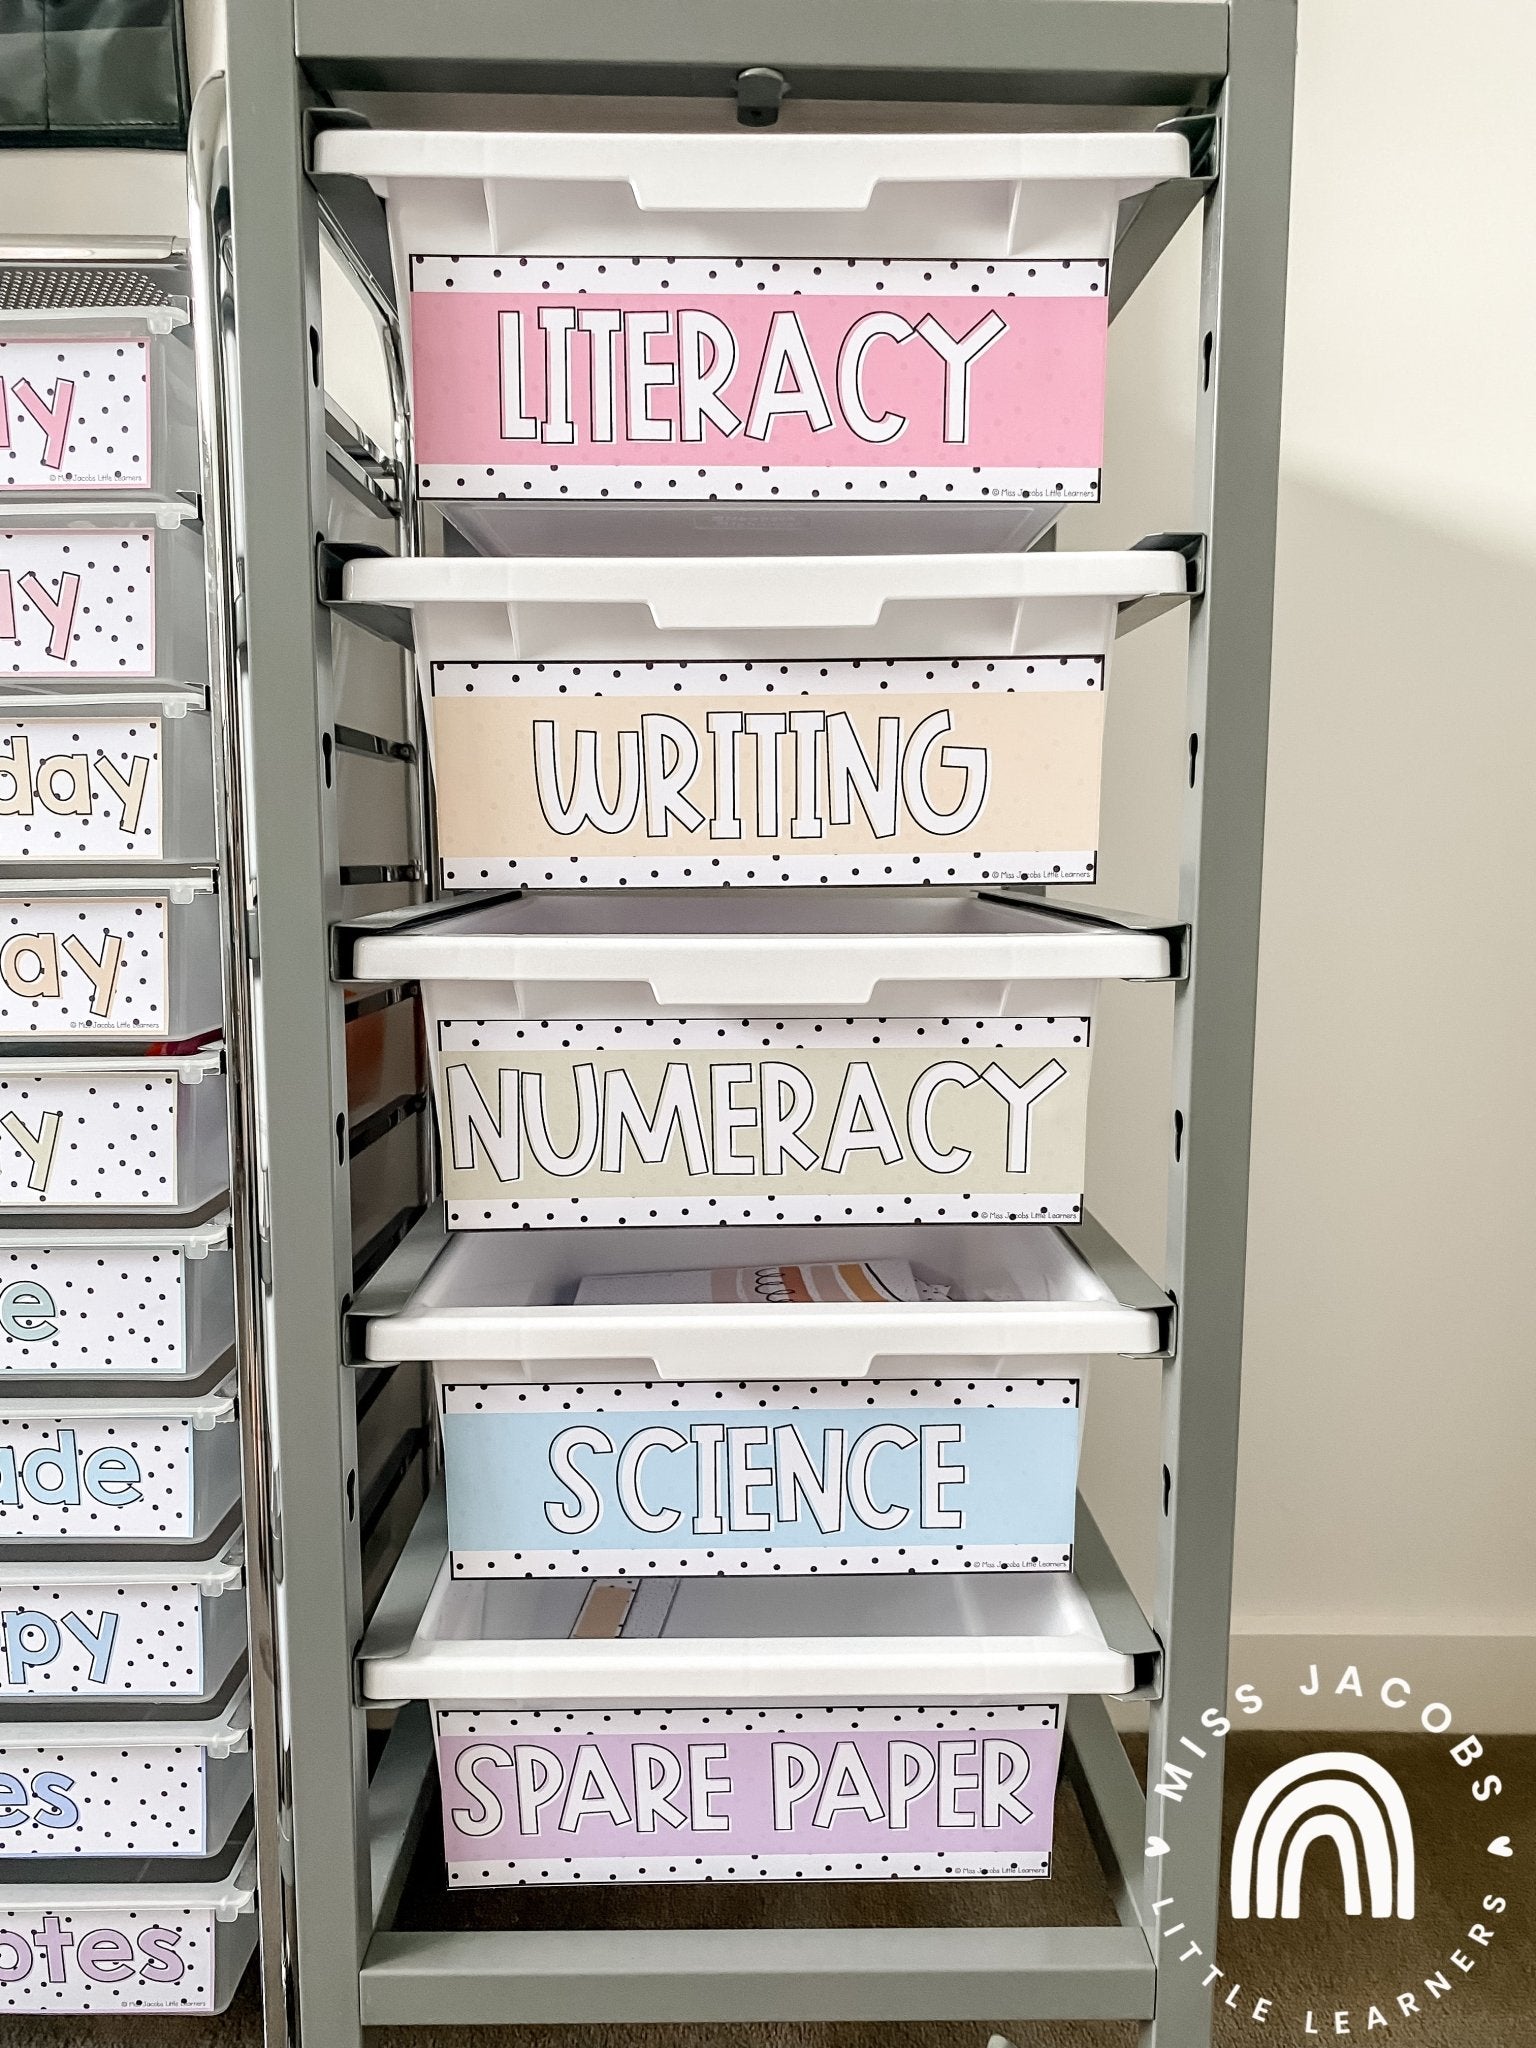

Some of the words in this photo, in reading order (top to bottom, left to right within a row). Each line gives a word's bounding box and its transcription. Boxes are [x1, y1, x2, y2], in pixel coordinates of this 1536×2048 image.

[498, 306, 1007, 445] LITERACY
[0, 375, 75, 470] y
[72, 474, 96, 482] Jacobs
[98, 474, 112, 482] Little
[1001, 488, 1016, 497] Miss
[1018, 488, 1043, 497] Jcobs
[1045, 488, 1062, 497] Little
[1064, 488, 1094, 497] Learners
[0, 570, 81, 661] y
[0, 736, 150, 834] day
[533, 709, 988, 839] WRITING
[1000, 871, 1014, 879] Miss
[1016, 870, 1041, 879] Jcobs
[1043, 870, 1059, 878] Little
[1060, 870, 1091, 878] Learners
[0, 932, 122, 1017] ay
[0, 1111, 62, 1192] y
[446, 1058, 1067, 1182] NUMERACY
[0, 1280, 58, 1342] e
[544, 1423, 966, 1535] SCIENCE
[982, 1560, 995, 1568] Miss
[997, 1560, 1020, 1568] Jcobs
[1021, 1560, 1037, 1568] Little
[1038, 1560, 1067, 1568] Learners
[0, 1610, 119, 1684] py
[0, 1771, 79, 1829] es
[451, 1742, 733, 1837] SPARE
[770, 1738, 1034, 1830] PAPER
[0, 1916, 185, 1983] otes
